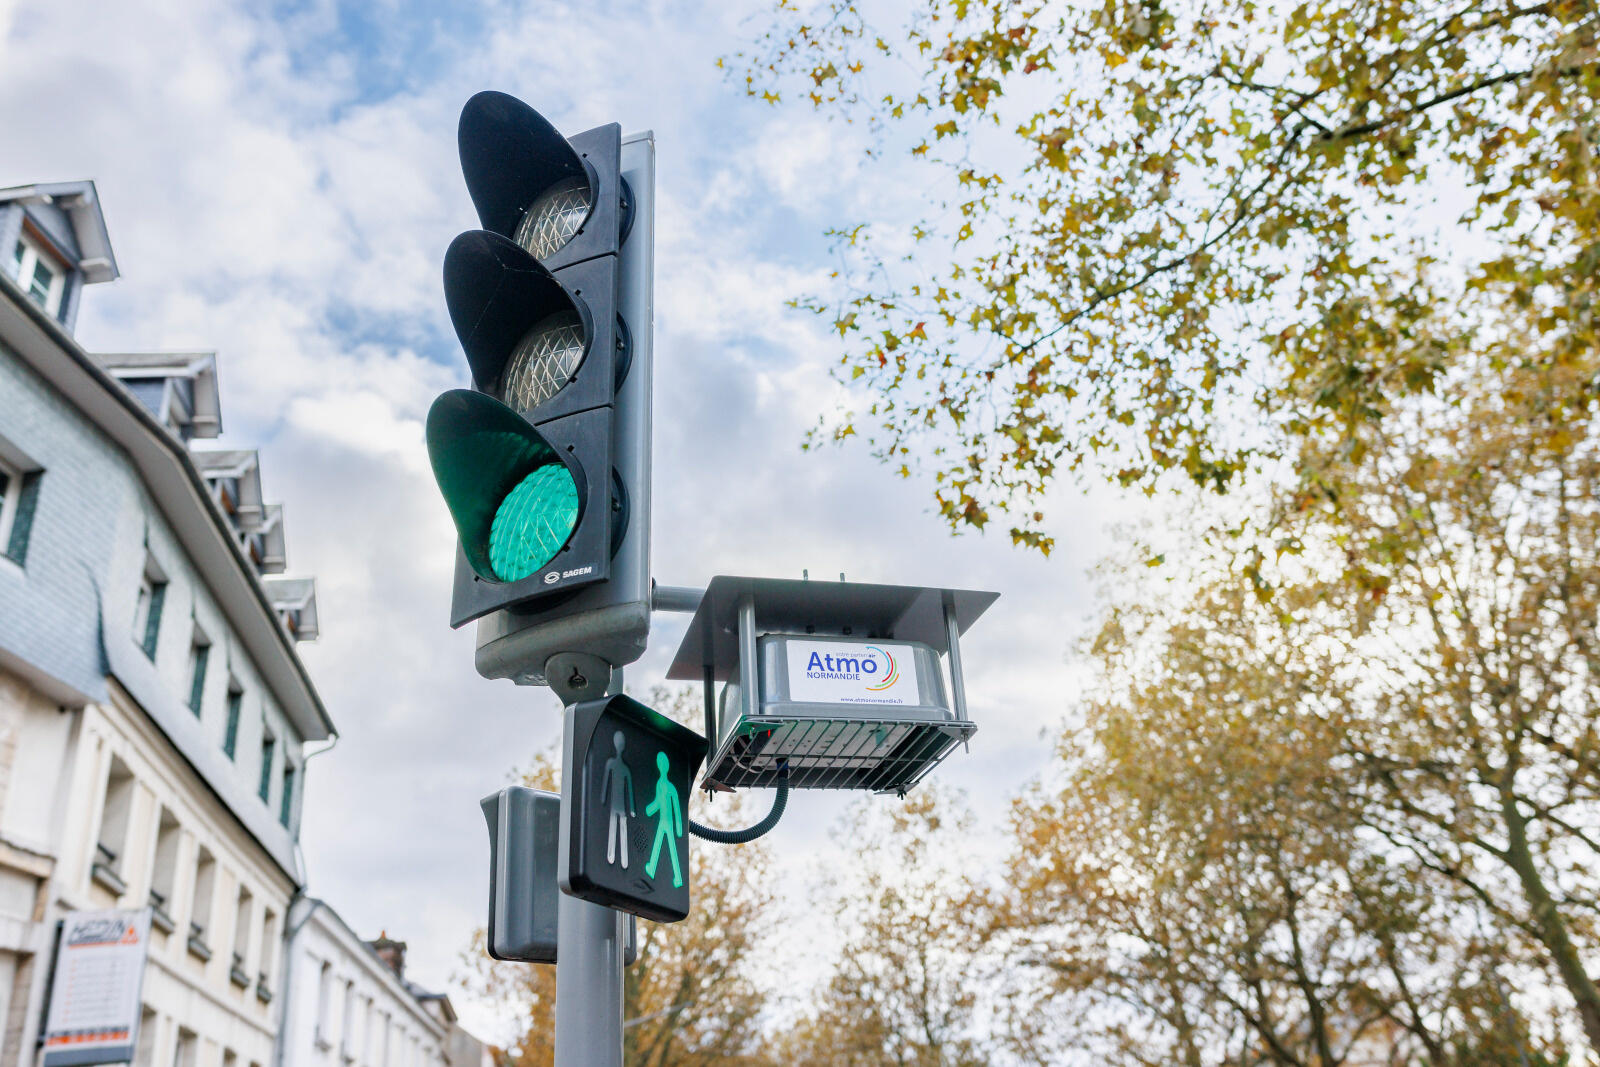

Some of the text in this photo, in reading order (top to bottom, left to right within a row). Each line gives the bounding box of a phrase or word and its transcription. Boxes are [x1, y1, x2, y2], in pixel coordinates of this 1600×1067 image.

[562, 566, 592, 578] SAGEM
[807, 651, 878, 674] Atmo
[806, 671, 861, 681] NORMANDIE
